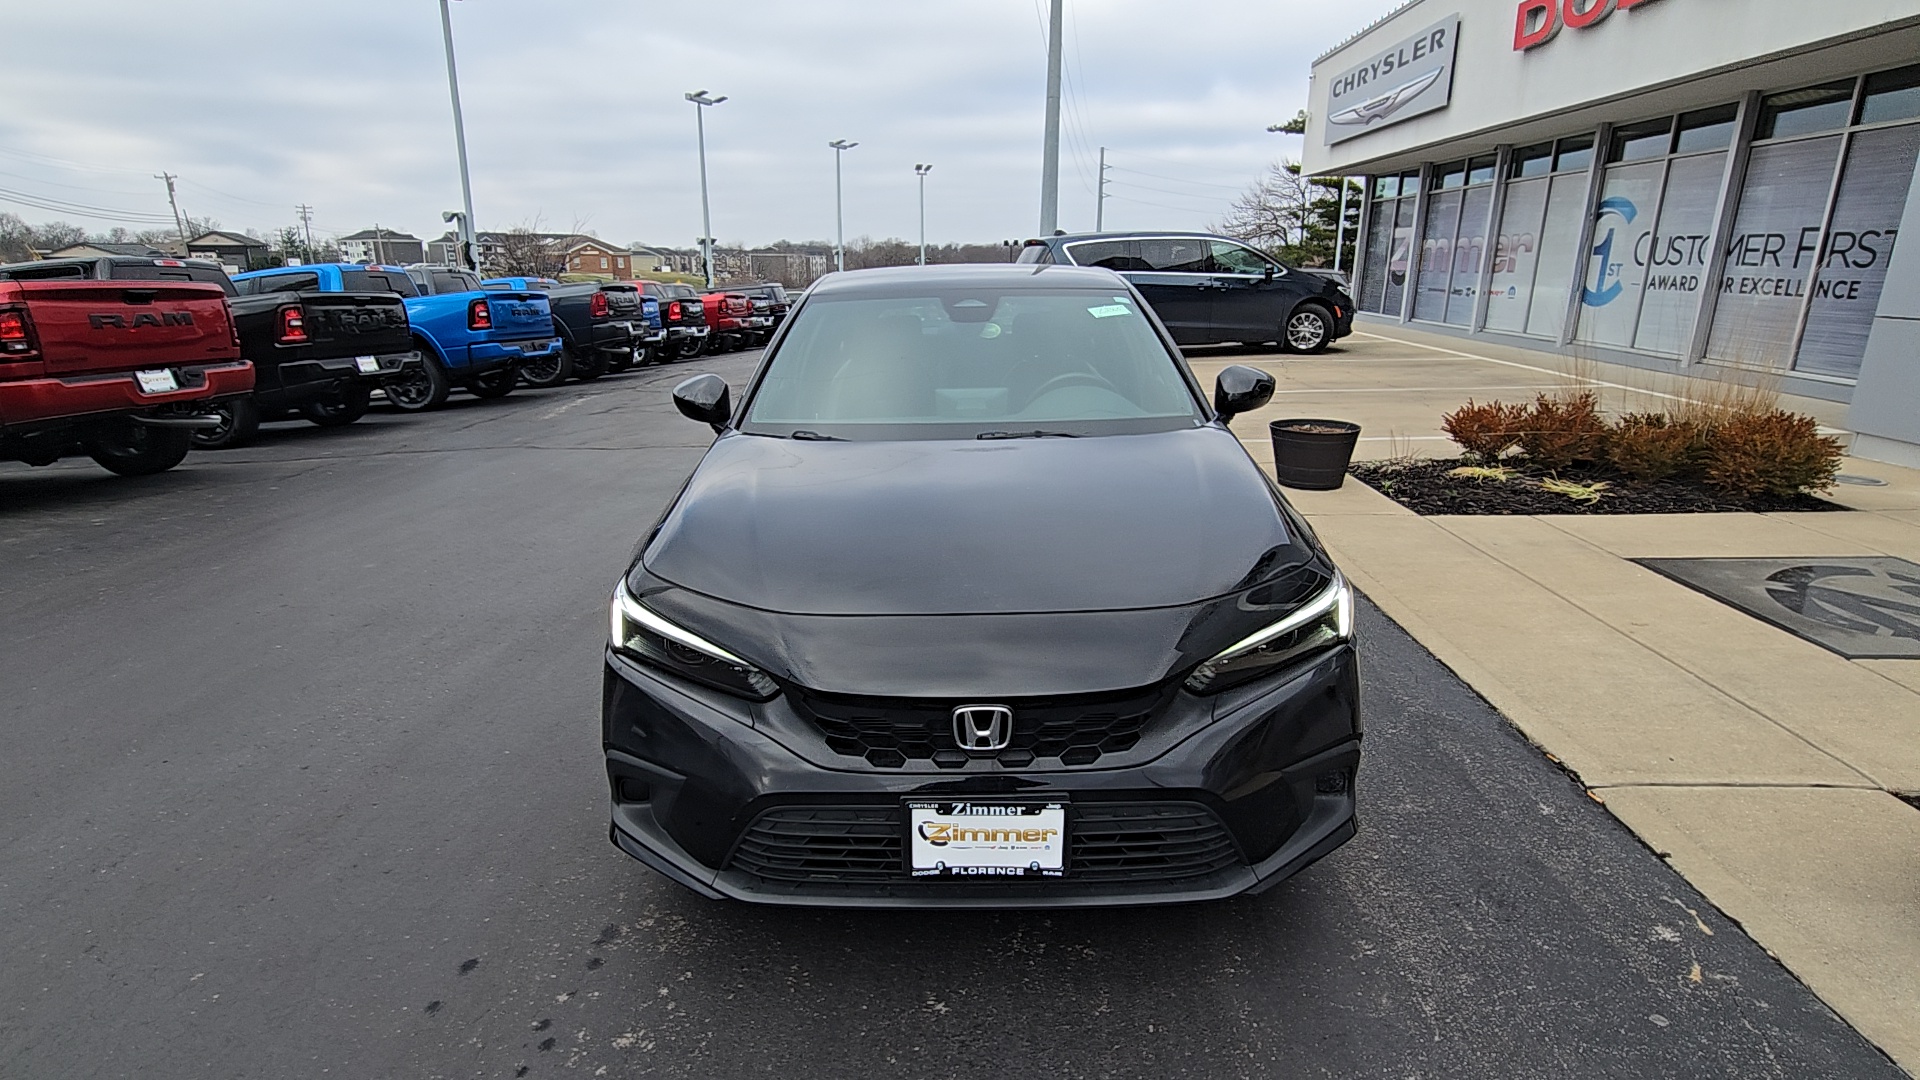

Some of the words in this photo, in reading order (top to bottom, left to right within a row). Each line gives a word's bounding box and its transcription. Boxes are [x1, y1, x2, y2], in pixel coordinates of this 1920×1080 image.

[1513, 0, 1648, 51] DO
[1332, 28, 1446, 98] CHRYSLER
[1390, 227, 1534, 273] Zmmer
[1793, 227, 1898, 268] FRST
[1648, 275, 1698, 291] AWARD
[1739, 277, 1861, 299] EXCELLNCE
[88, 311, 194, 329] RAM
[341, 314, 386, 325] RAM
[951, 802, 1026, 816] Zimmer
[927, 823, 1058, 842] Zimmer
[911, 869, 940, 877] DODGE
[952, 867, 1025, 876] FLORENCE
